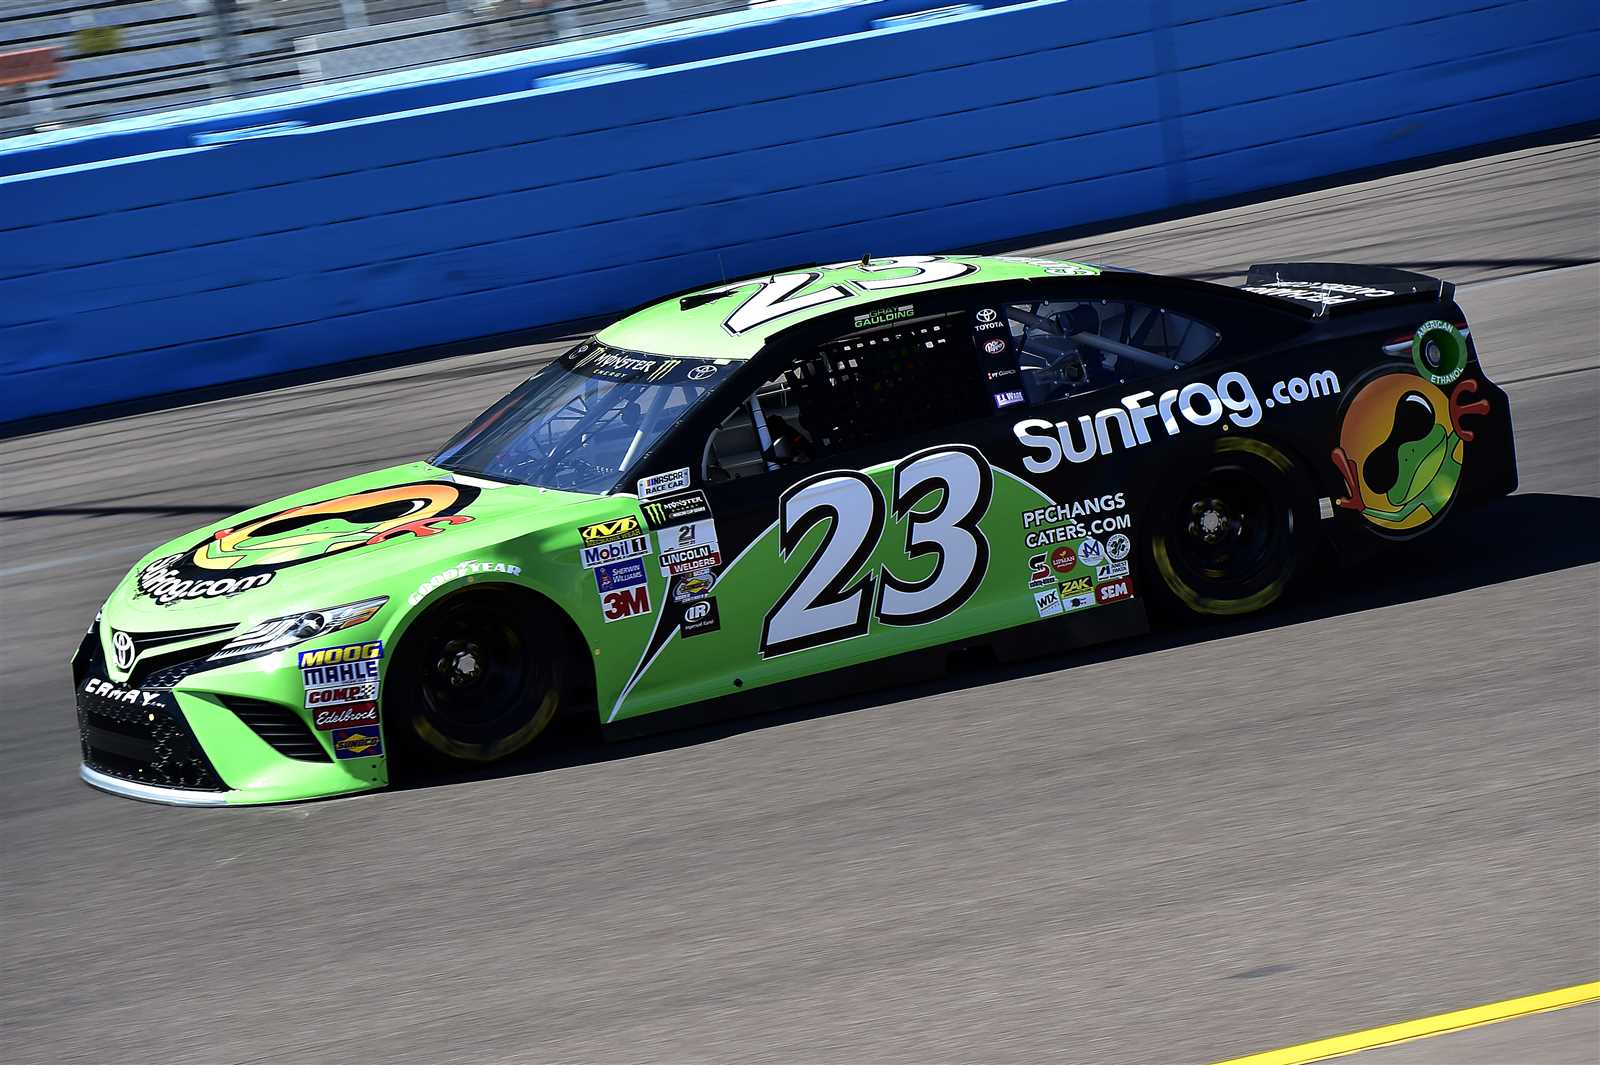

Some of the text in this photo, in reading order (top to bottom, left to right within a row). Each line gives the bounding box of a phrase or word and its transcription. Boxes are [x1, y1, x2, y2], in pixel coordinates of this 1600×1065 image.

[710, 255, 982, 337] 23
[854, 310, 914, 328] GAULDING
[870, 305, 897, 317] GRAY
[974, 321, 1004, 332] TOYOTA
[1417, 319, 1454, 339] AMERICAN
[594, 353, 656, 373] MONSTER
[593, 368, 628, 378] ENERGY
[1430, 367, 1464, 385] ETHANOL
[653, 471, 683, 484] NASCAR
[645, 480, 684, 495] RACE CAR
[663, 496, 703, 510] MONSTER
[1023, 492, 1126, 528] PFCHANGS
[1025, 513, 1131, 548] CATERS.COM
[584, 540, 629, 563] Mobil
[662, 547, 709, 566] LINCOLN
[758, 443, 994, 661] 23
[612, 564, 640, 576] SHERWIN
[674, 557, 716, 573] WELDERS
[407, 559, 522, 606] GOODYEAR
[612, 572, 643, 583] WILLIAMS
[1062, 578, 1089, 594] ZAK
[1037, 590, 1057, 608] WIX
[1101, 582, 1128, 600] SEM
[603, 586, 650, 620] 3M
[689, 604, 706, 620] IR
[301, 642, 380, 667] MOOG
[303, 661, 378, 685] MAHLE
[308, 686, 361, 704] COMP
[316, 707, 377, 725] Edelbrock
